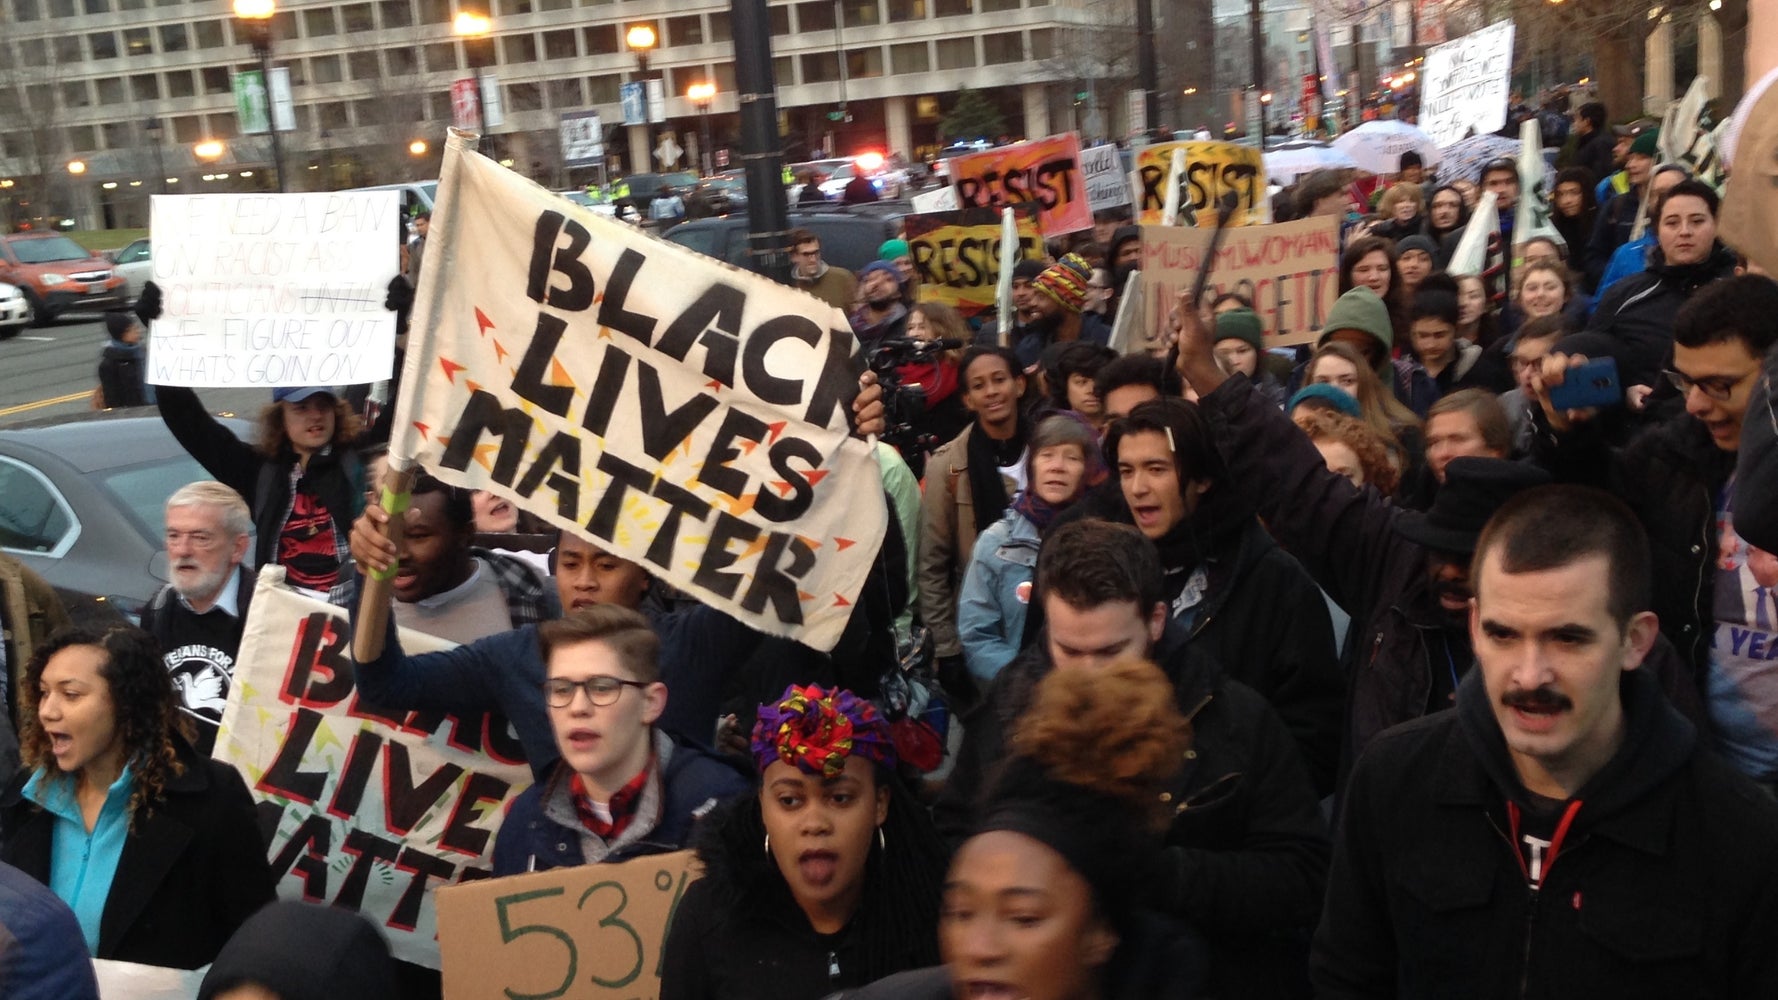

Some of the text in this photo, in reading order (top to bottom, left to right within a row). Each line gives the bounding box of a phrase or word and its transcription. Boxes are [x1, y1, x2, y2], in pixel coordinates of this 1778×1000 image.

[957, 158, 1074, 211] RESIST
[1140, 161, 1257, 210] RSIST
[218, 196, 281, 235] EED
[289, 197, 308, 234] A
[320, 195, 389, 234] BAN
[154, 243, 201, 279] ON
[213, 240, 300, 276] RACIST
[299, 281, 377, 315] UNTIL
[527, 209, 864, 429] BLACK
[224, 318, 319, 350] FIGURE
[328, 319, 383, 348] OUT
[154, 352, 361, 383] WHAT'S GOIN ON
[510, 312, 824, 522] LIVES
[440, 389, 816, 626] MATTER
[208, 647, 234, 670] FOR
[255, 708, 514, 857] LIVE
